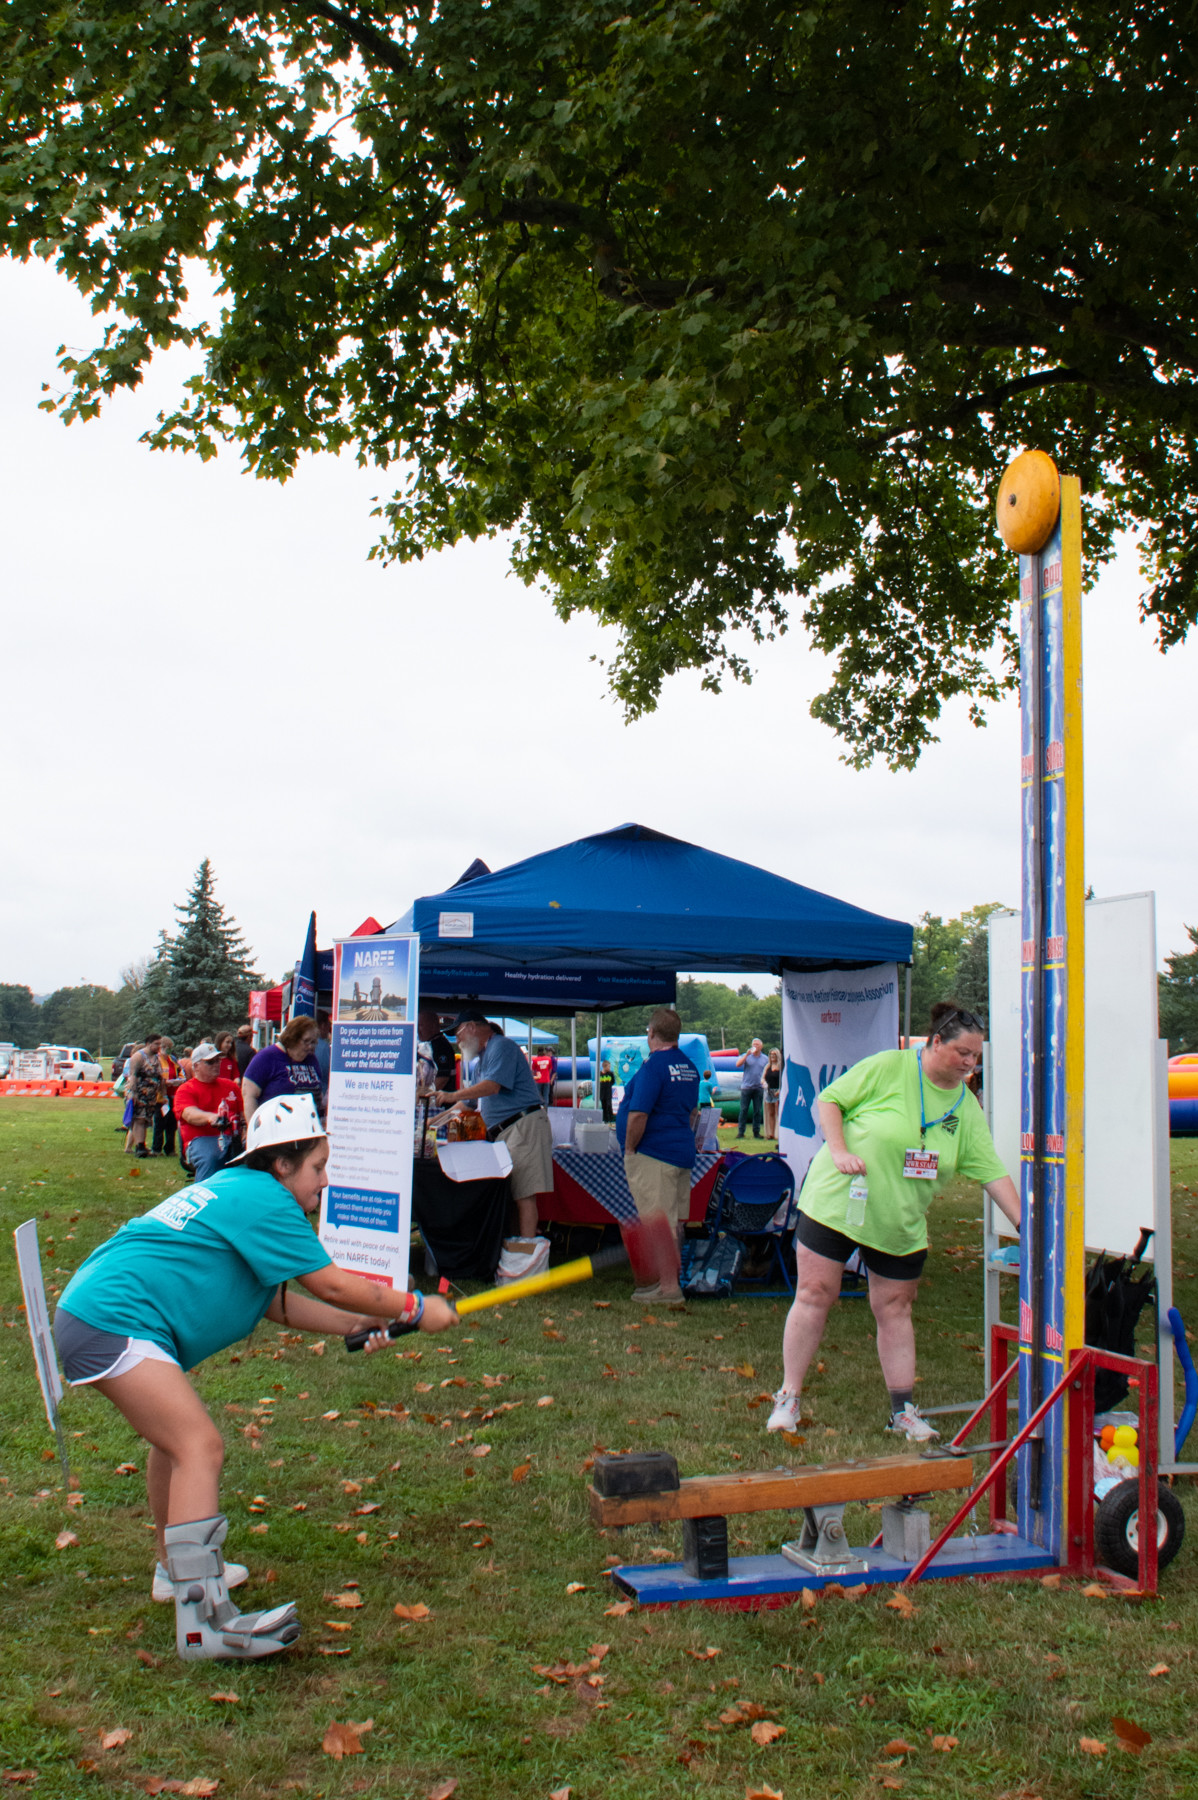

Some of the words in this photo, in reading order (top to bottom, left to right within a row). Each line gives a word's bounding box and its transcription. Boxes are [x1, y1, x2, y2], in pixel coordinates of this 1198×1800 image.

[354, 950, 395, 968] NARFE
[504, 971, 527, 981] Healthy
[527, 972, 555, 981] hydration
[555, 974, 582, 982] delivered
[611, 976, 667, 985] ReadyRefresh.com
[340, 1026, 348, 1035] Do
[348, 1028, 358, 1037] you
[359, 1027, 371, 1036] plan
[377, 1027, 391, 1036] retire
[391, 1027, 404, 1036] from
[340, 1037, 349, 1045] the
[350, 1036, 369, 1046] federal
[369, 1037, 402, 1047] government?
[341, 1049, 351, 1058] Let
[359, 1049, 367, 1058] be
[367, 1051, 380, 1060] your
[379, 1050, 400, 1060] partner
[344, 1060, 358, 1068] over
[358, 1059, 368, 1069] the
[368, 1059, 384, 1069] finish
[383, 1060, 396, 1069] line!
[345, 1079, 356, 1089] We
[357, 1081, 369, 1090] are
[370, 1080, 394, 1091] NARFE
[905, 1160, 919, 1168] MWR
[919, 1161, 937, 1169] STAFF
[332, 1190, 342, 1199] Your
[342, 1192, 361, 1201] benefits
[334, 1202, 351, 1211] protect
[363, 1205, 372, 1213] and
[372, 1206, 383, 1216] help
[382, 1209, 392, 1217] you
[350, 1214, 358, 1222] the
[358, 1216, 369, 1224] most
[375, 1217, 388, 1226] them.
[323, 1234, 338, 1244] Retire
[339, 1237, 350, 1246] well
[351, 1239, 362, 1247] with
[362, 1241, 378, 1250] peace
[379, 1243, 386, 1251] of
[386, 1245, 400, 1254] mind.
[332, 1249, 345, 1259] Join
[346, 1251, 369, 1264] NARFE
[370, 1256, 391, 1270] today!
